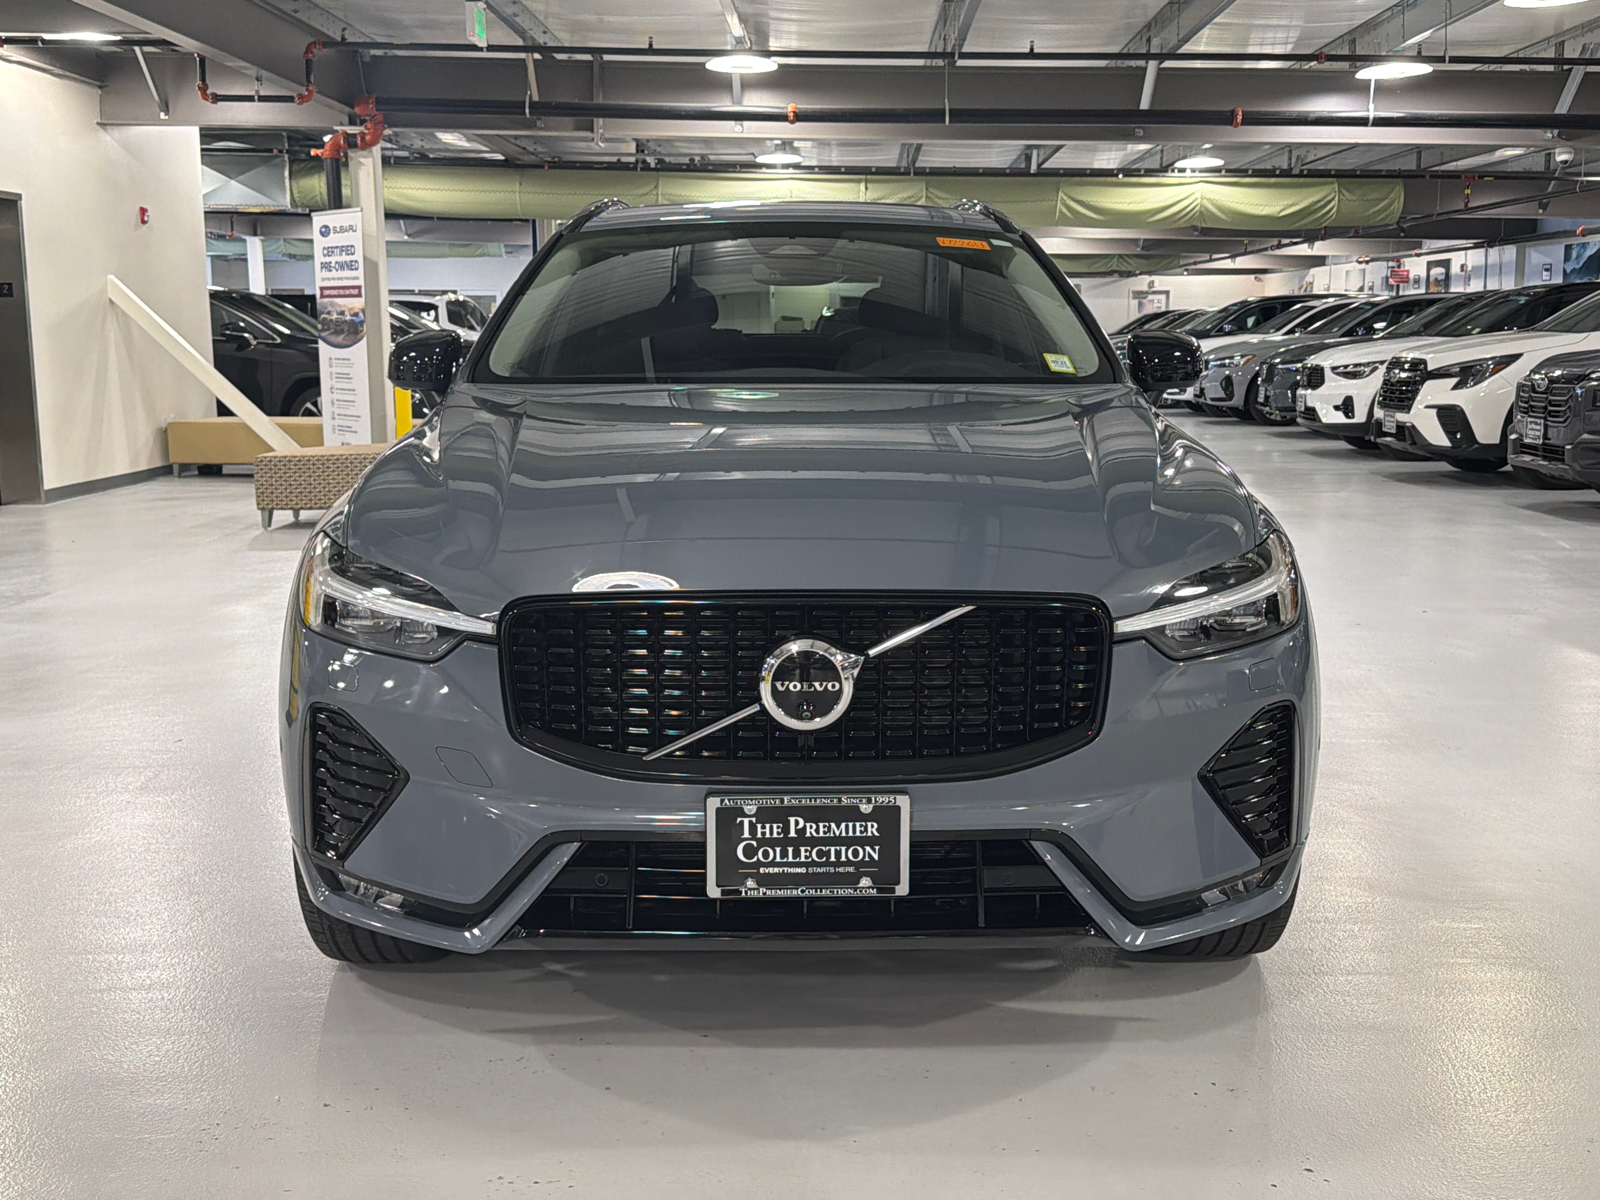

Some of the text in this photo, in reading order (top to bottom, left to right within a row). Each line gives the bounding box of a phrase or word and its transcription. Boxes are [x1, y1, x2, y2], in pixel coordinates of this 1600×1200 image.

[332, 224, 357, 234] SUBARU
[322, 244, 355, 257] CERTIFIED
[320, 260, 359, 272] PRE-OWNED
[3, 284, 9, 294] 2
[773, 681, 840, 692] VOLVO
[722, 796, 895, 806] AUTOMOTIVE EXCELLENCE SINCE 1995
[736, 816, 880, 838] THE PREMIER
[736, 840, 880, 863] COLLECTION
